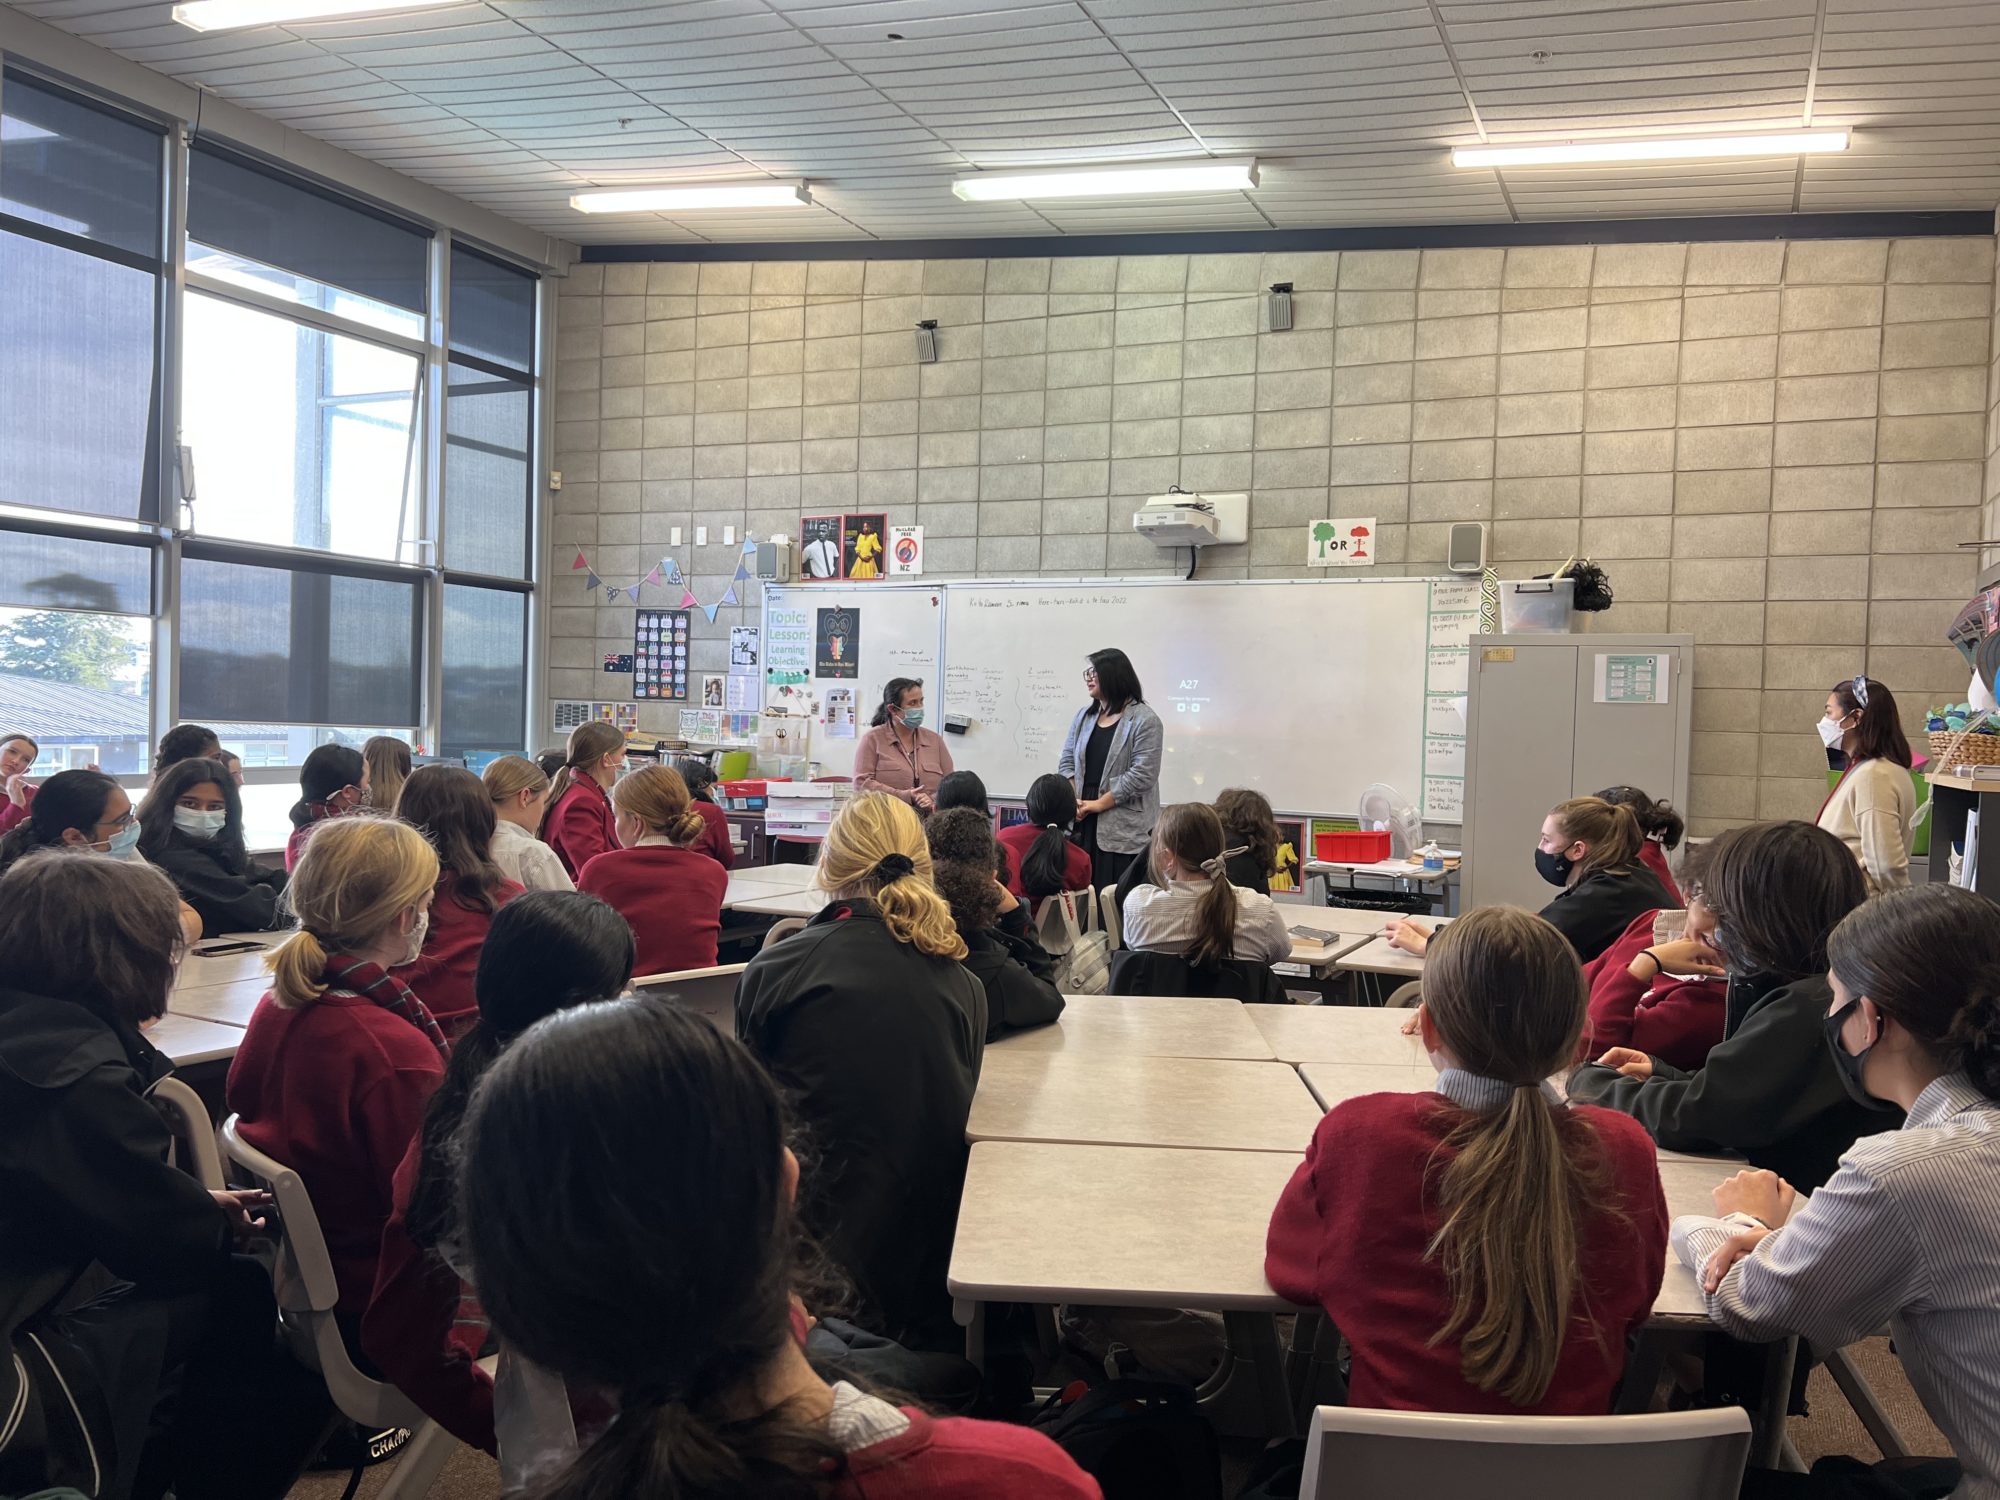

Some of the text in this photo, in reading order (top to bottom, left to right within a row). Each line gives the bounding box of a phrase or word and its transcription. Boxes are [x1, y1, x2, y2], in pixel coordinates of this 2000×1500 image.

[1330, 540, 1347, 550] OR
[900, 564, 911, 572] NZ
[769, 610, 807, 624] Topic:
[769, 629, 811, 641] Lesson:
[771, 644, 805, 656] Learning
[1179, 680, 1199, 689] A27
